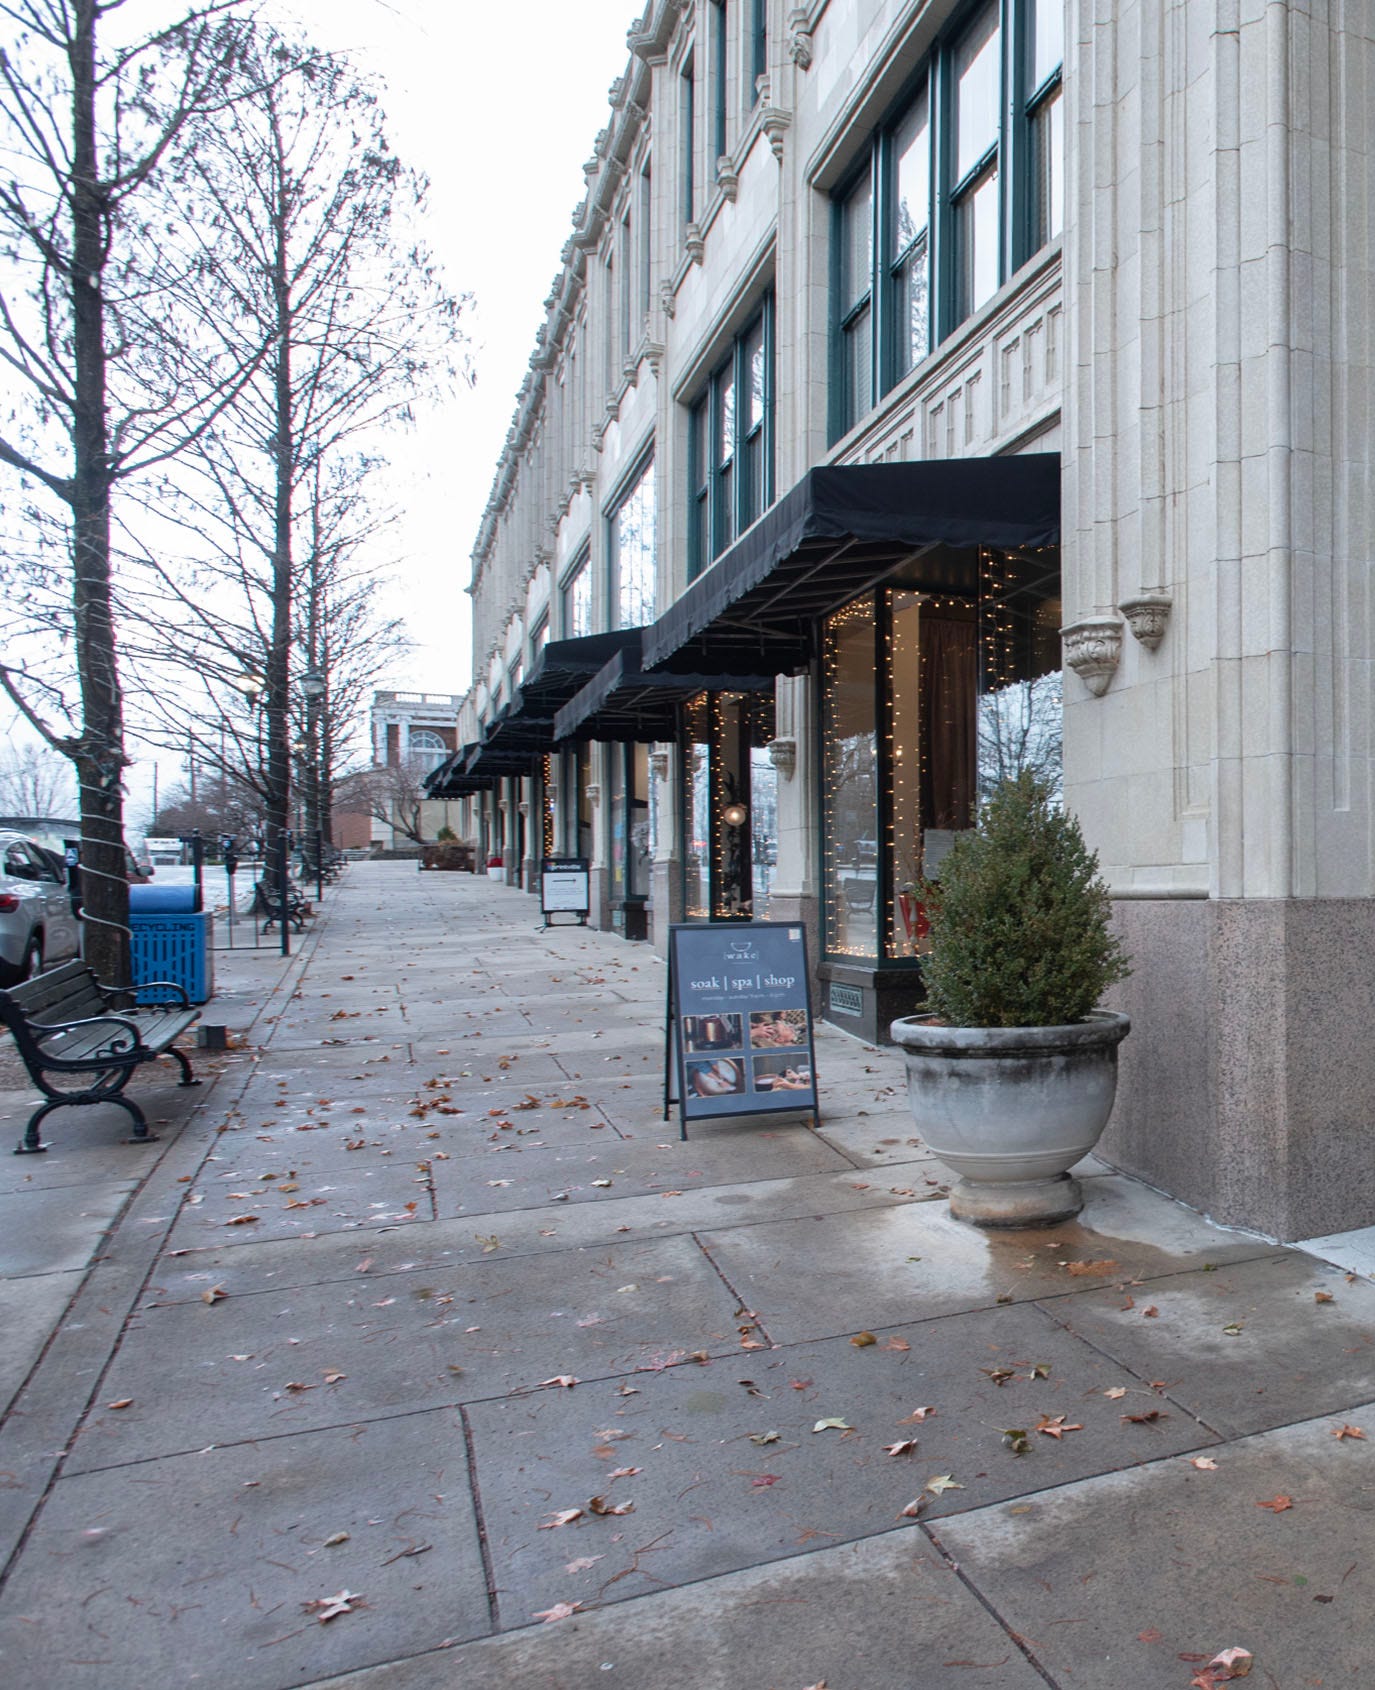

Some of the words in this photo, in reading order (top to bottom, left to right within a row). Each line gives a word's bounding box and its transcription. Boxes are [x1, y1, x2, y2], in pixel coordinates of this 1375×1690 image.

[131, 923, 196, 932] ECYCLING
[690, 976, 720, 989] soak
[731, 978, 753, 990] spa
[763, 974, 795, 989] shop
